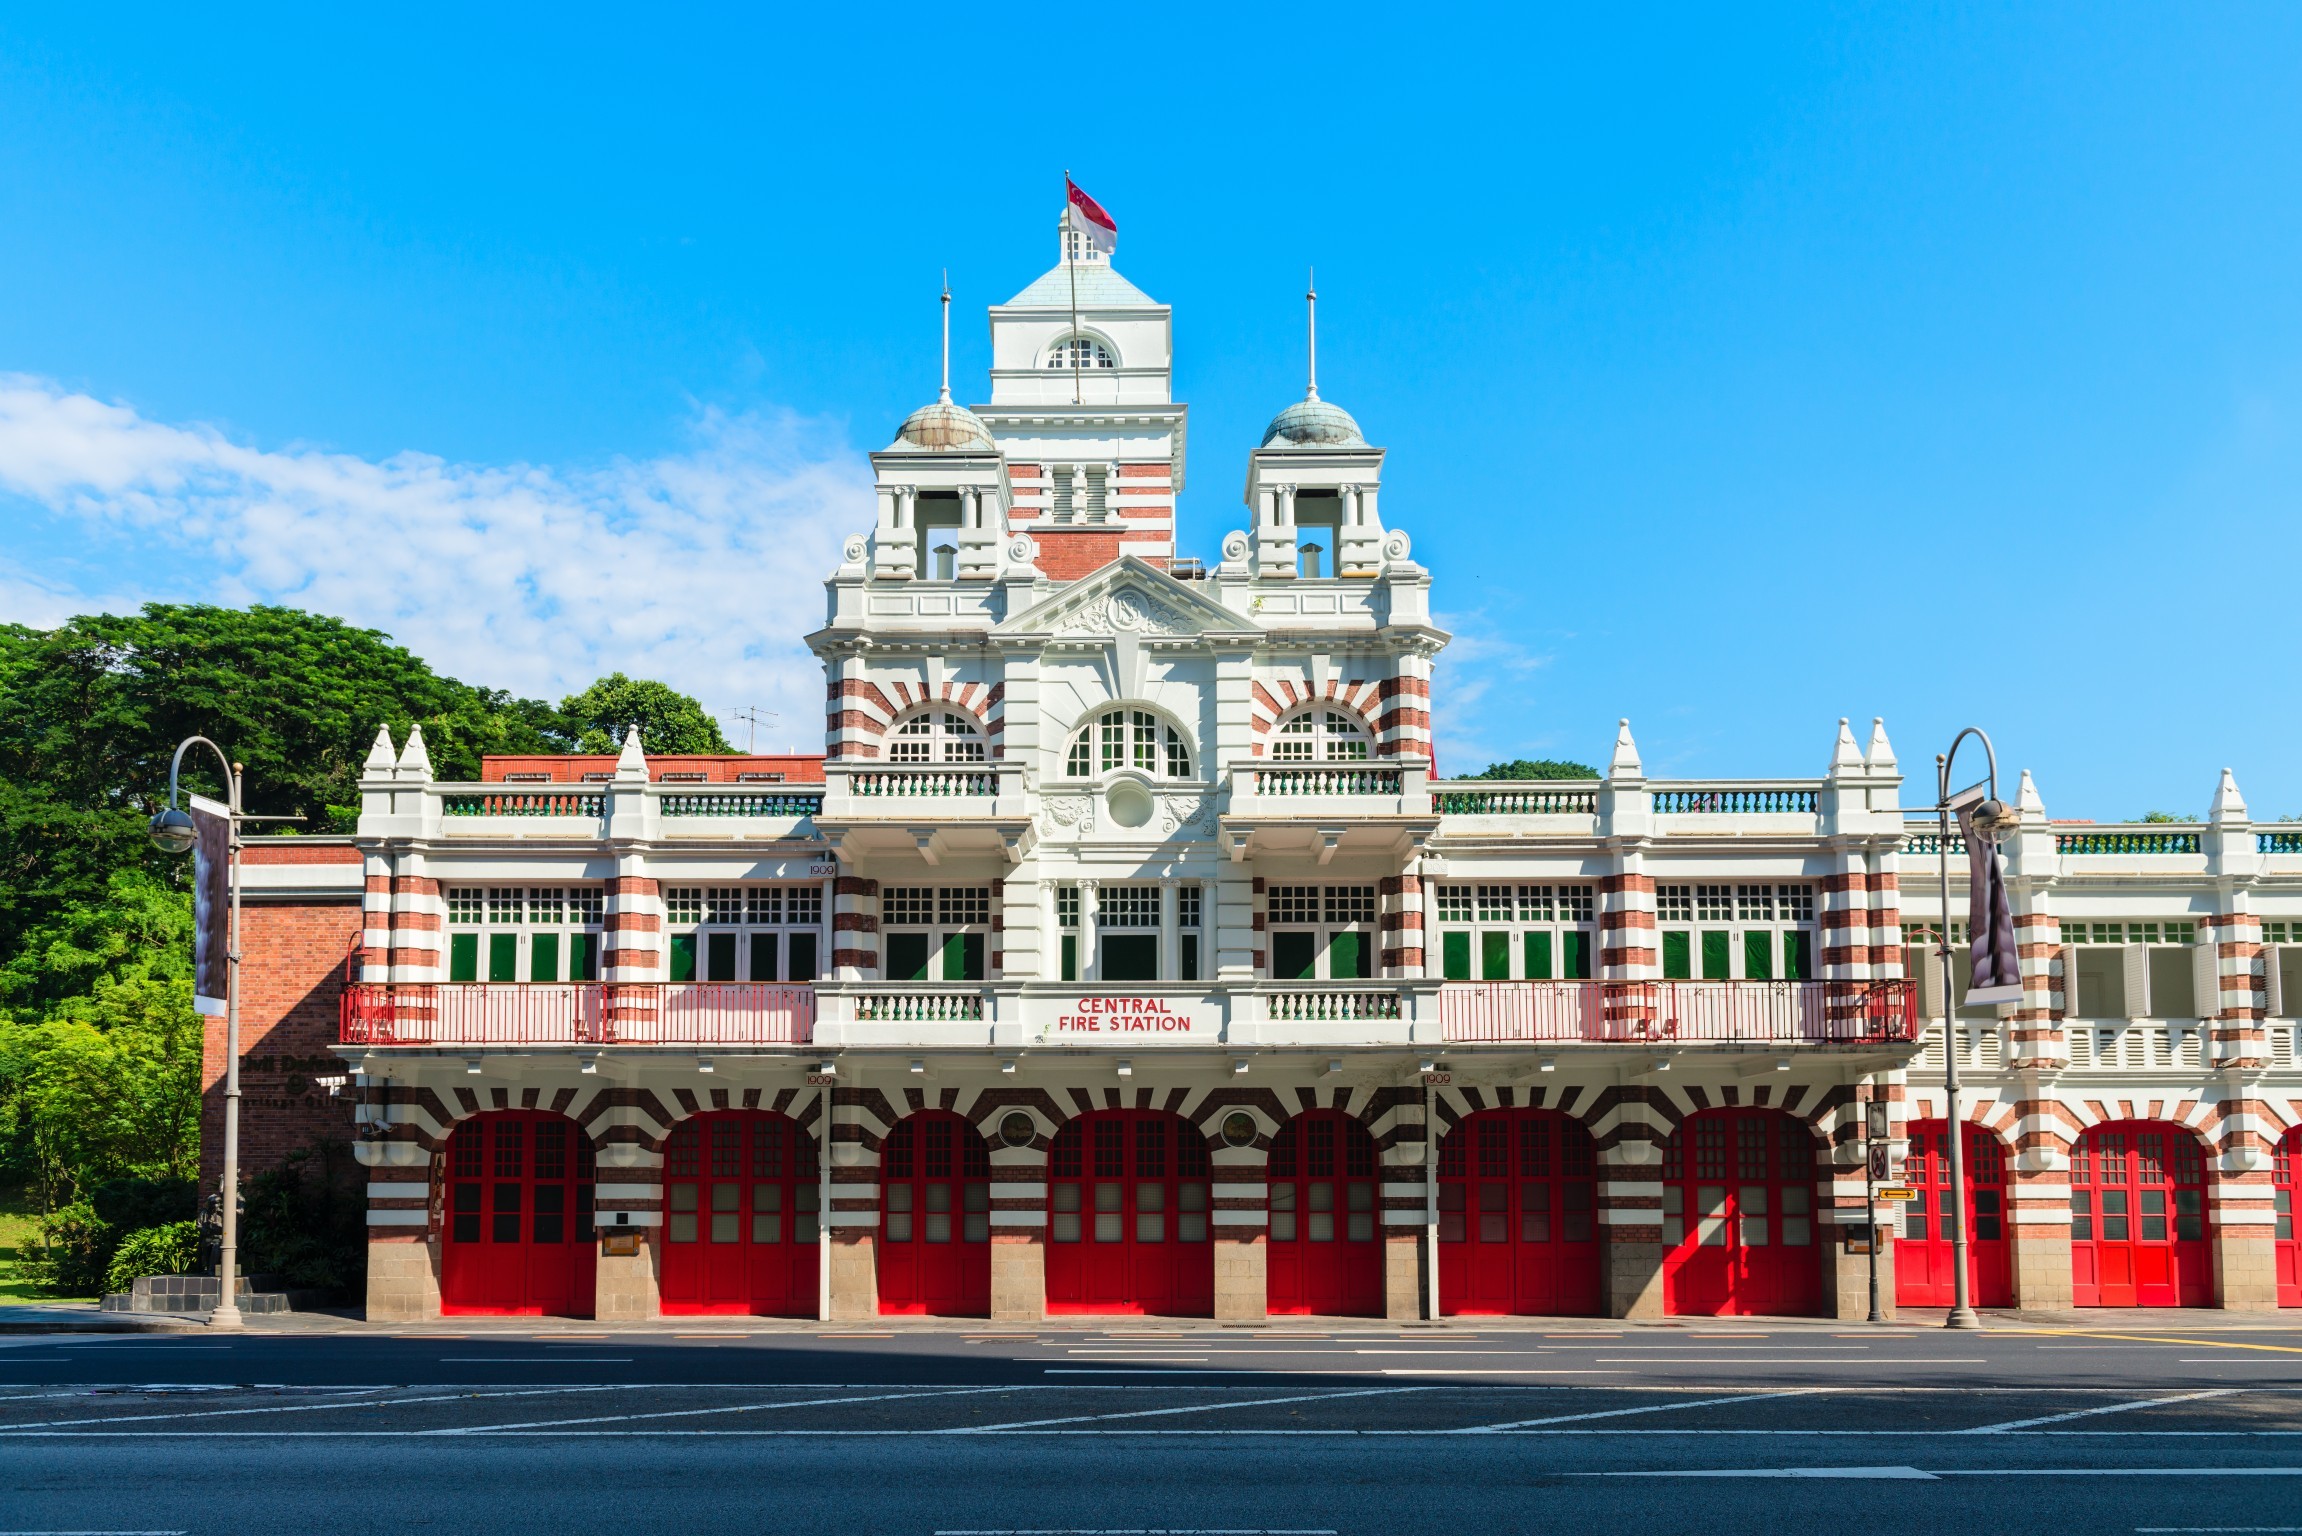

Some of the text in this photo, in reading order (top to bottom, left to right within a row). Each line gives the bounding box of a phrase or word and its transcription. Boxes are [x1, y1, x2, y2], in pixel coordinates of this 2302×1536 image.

[810, 865, 834, 875] 1909
[1078, 998, 1171, 1014] CENTRAL
[1059, 1016, 1191, 1031] FIRE STATION
[807, 1075, 832, 1085] 1909
[1426, 1073, 1451, 1084] 1909
